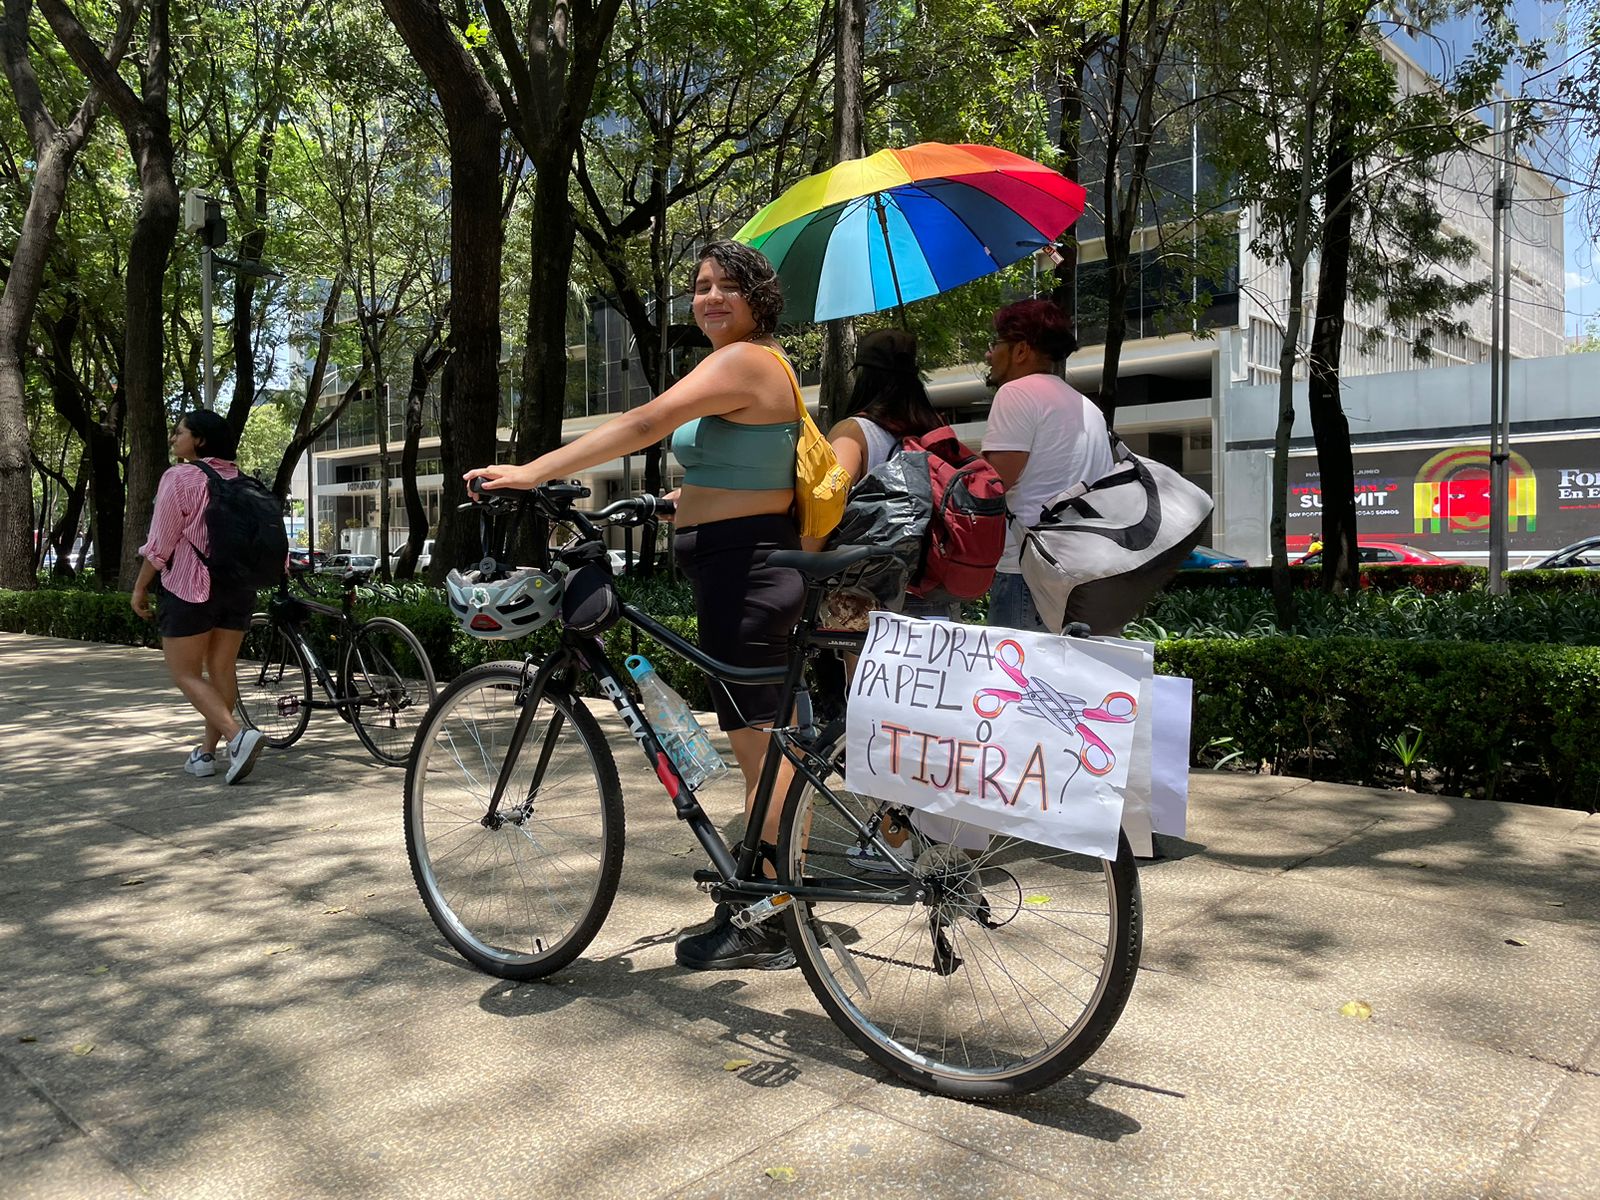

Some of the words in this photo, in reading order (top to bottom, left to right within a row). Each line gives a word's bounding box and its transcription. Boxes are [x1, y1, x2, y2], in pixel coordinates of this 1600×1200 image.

[1300, 491, 1388, 509] SUMIT
[1558, 488, 1584, 499] En
[868, 615, 994, 672] PIEDRA
[856, 658, 963, 711] PAPEL
